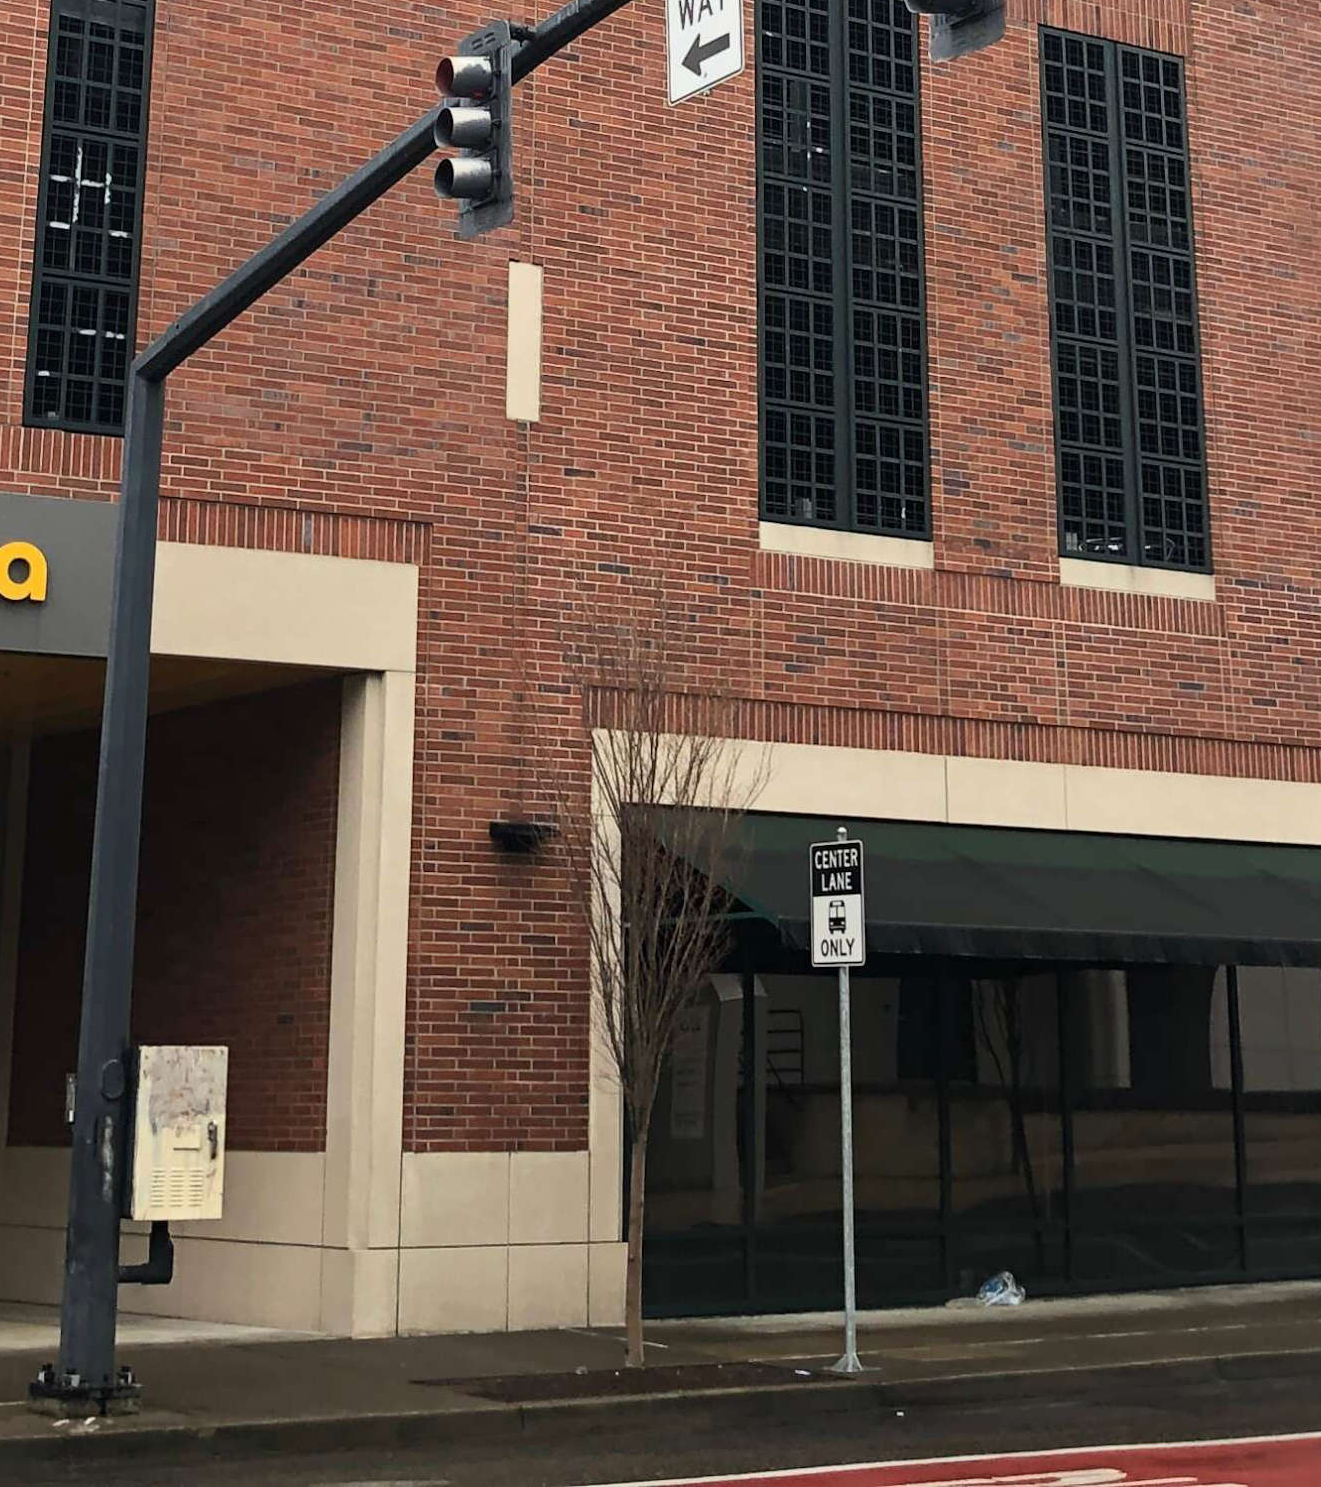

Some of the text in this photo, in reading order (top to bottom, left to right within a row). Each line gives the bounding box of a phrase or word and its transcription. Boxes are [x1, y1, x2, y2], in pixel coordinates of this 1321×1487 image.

[814, 848, 859, 869] CENTER
[821, 872, 852, 892] LANE
[821, 938, 855, 957] ONLY
